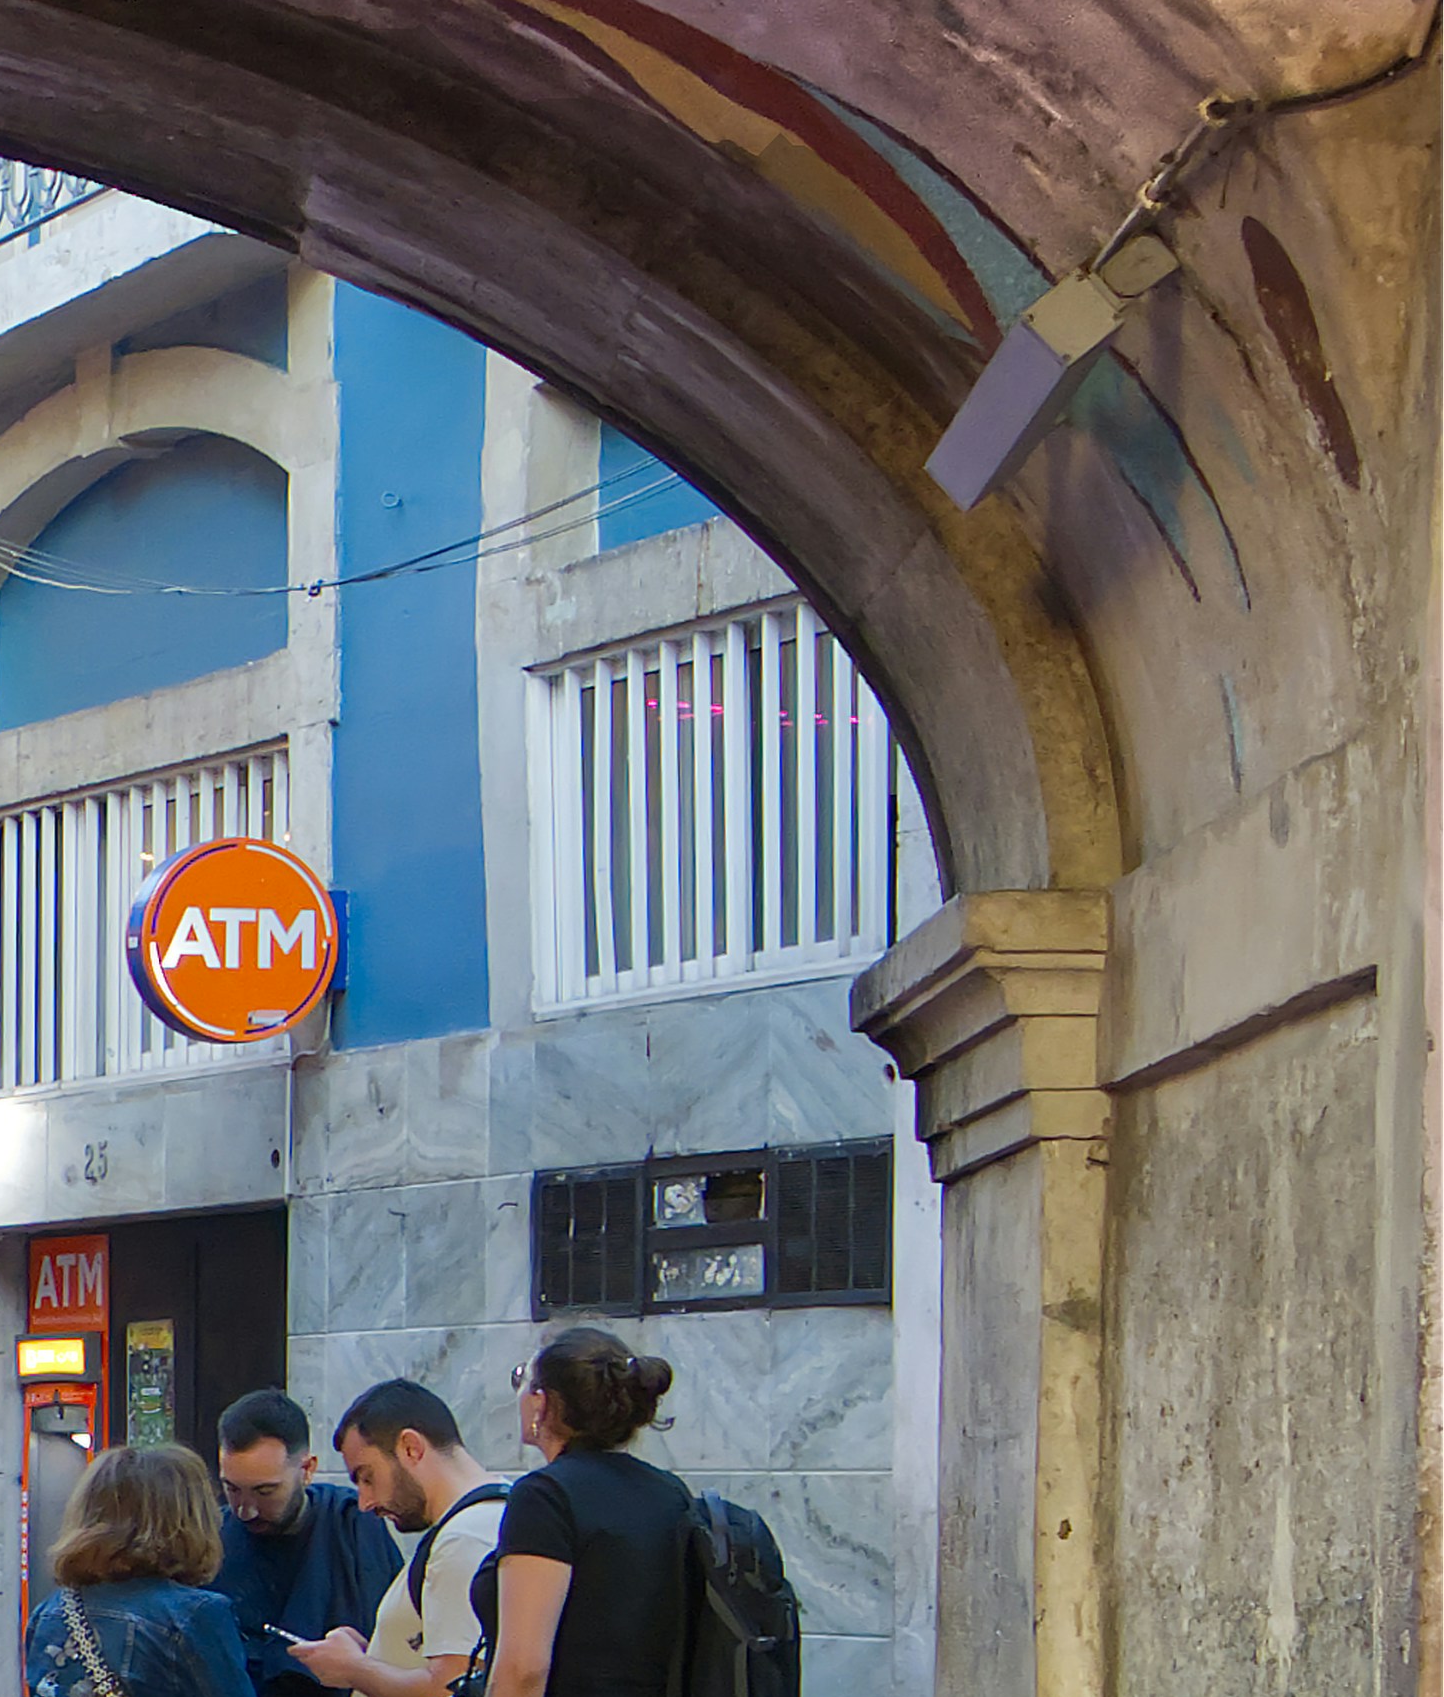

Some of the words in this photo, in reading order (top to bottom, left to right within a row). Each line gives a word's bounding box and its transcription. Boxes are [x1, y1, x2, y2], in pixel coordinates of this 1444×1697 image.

[162, 906, 316, 969] ATM
[84, 1140, 109, 1186] 25
[35, 1253, 102, 1310] ATM
